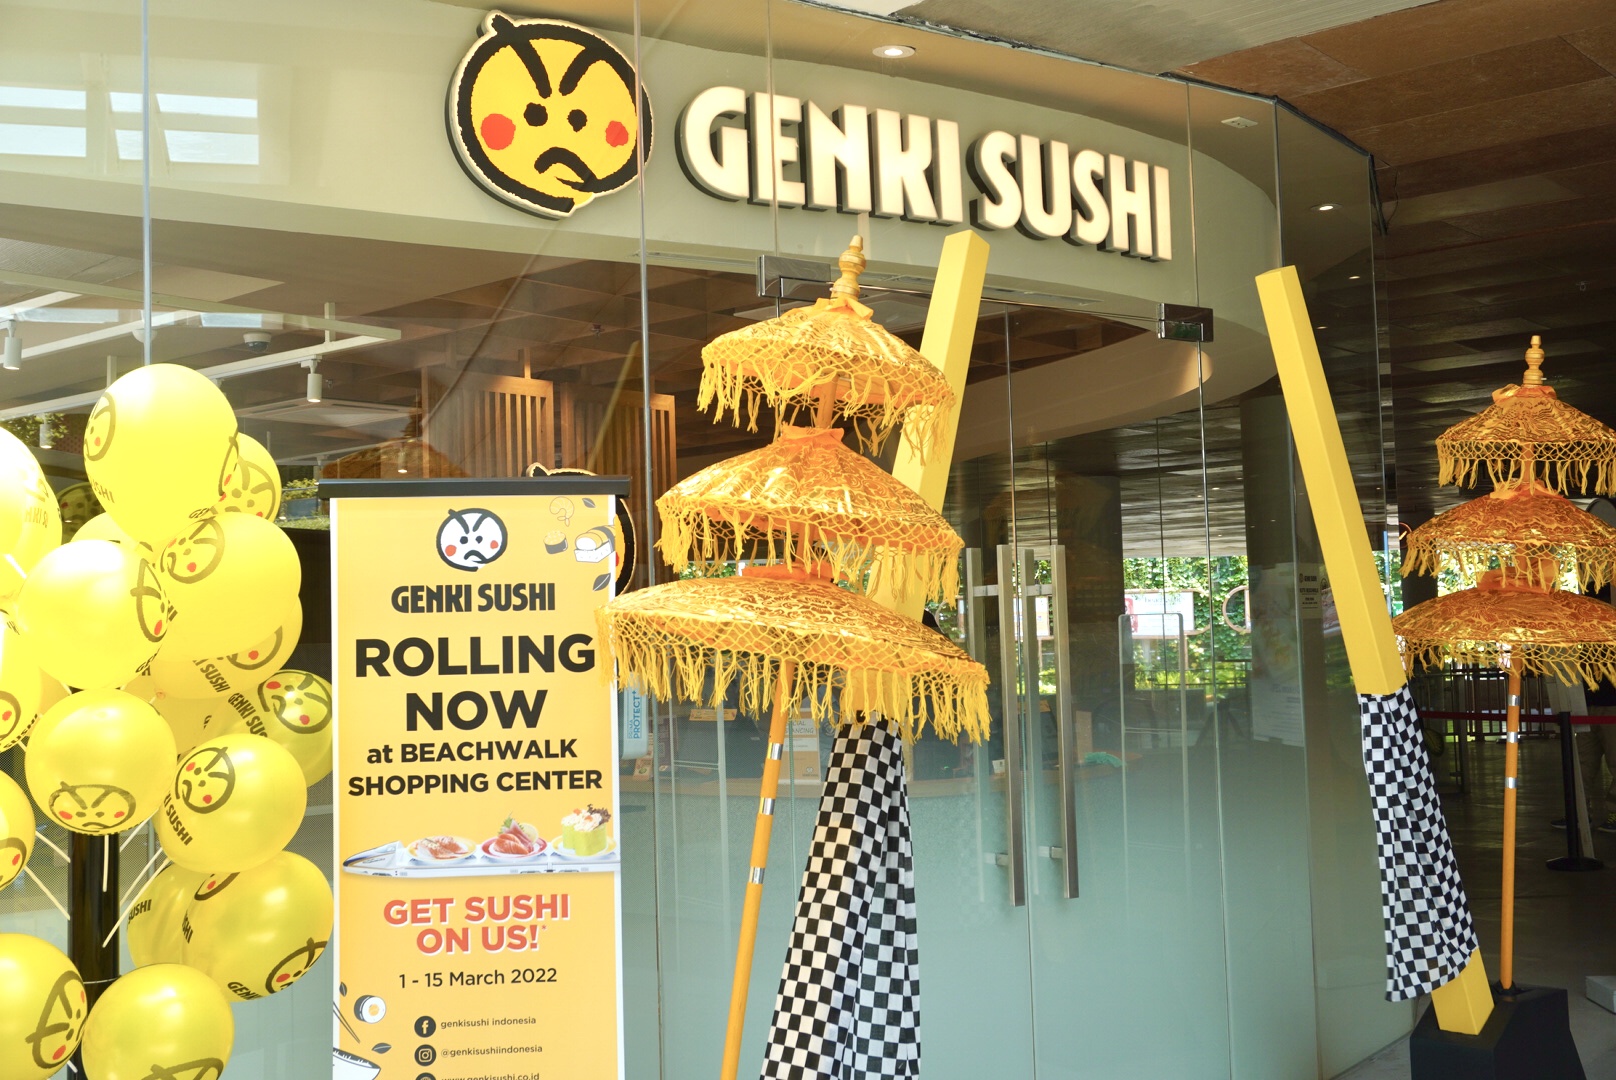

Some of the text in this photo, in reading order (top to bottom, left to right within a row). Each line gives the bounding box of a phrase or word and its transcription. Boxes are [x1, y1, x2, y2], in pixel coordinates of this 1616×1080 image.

[677, 86, 1172, 261] GENKI SUSHI
[391, 582, 556, 614] GENKI SUSHI
[355, 633, 595, 678] ROLLING
[200, 663, 231, 693] SUSHI
[227, 692, 256, 720] GENKI
[406, 689, 548, 731] NOW
[366, 738, 578, 764] at BEACHWALK
[348, 769, 602, 796] SHOPPING CENTER
[166, 804, 193, 846] SUSHI
[383, 894, 571, 926] GET SUSHI
[416, 927, 471, 955] ON
[399, 973, 406, 989] 1
[425, 972, 443, 987] 15
[449, 970, 505, 986] March
[511, 967, 557, 983] 2022
[440, 1016, 537, 1030] genkisushi indonesia
[441, 1044, 543, 1058] @genkisushiindonesia
